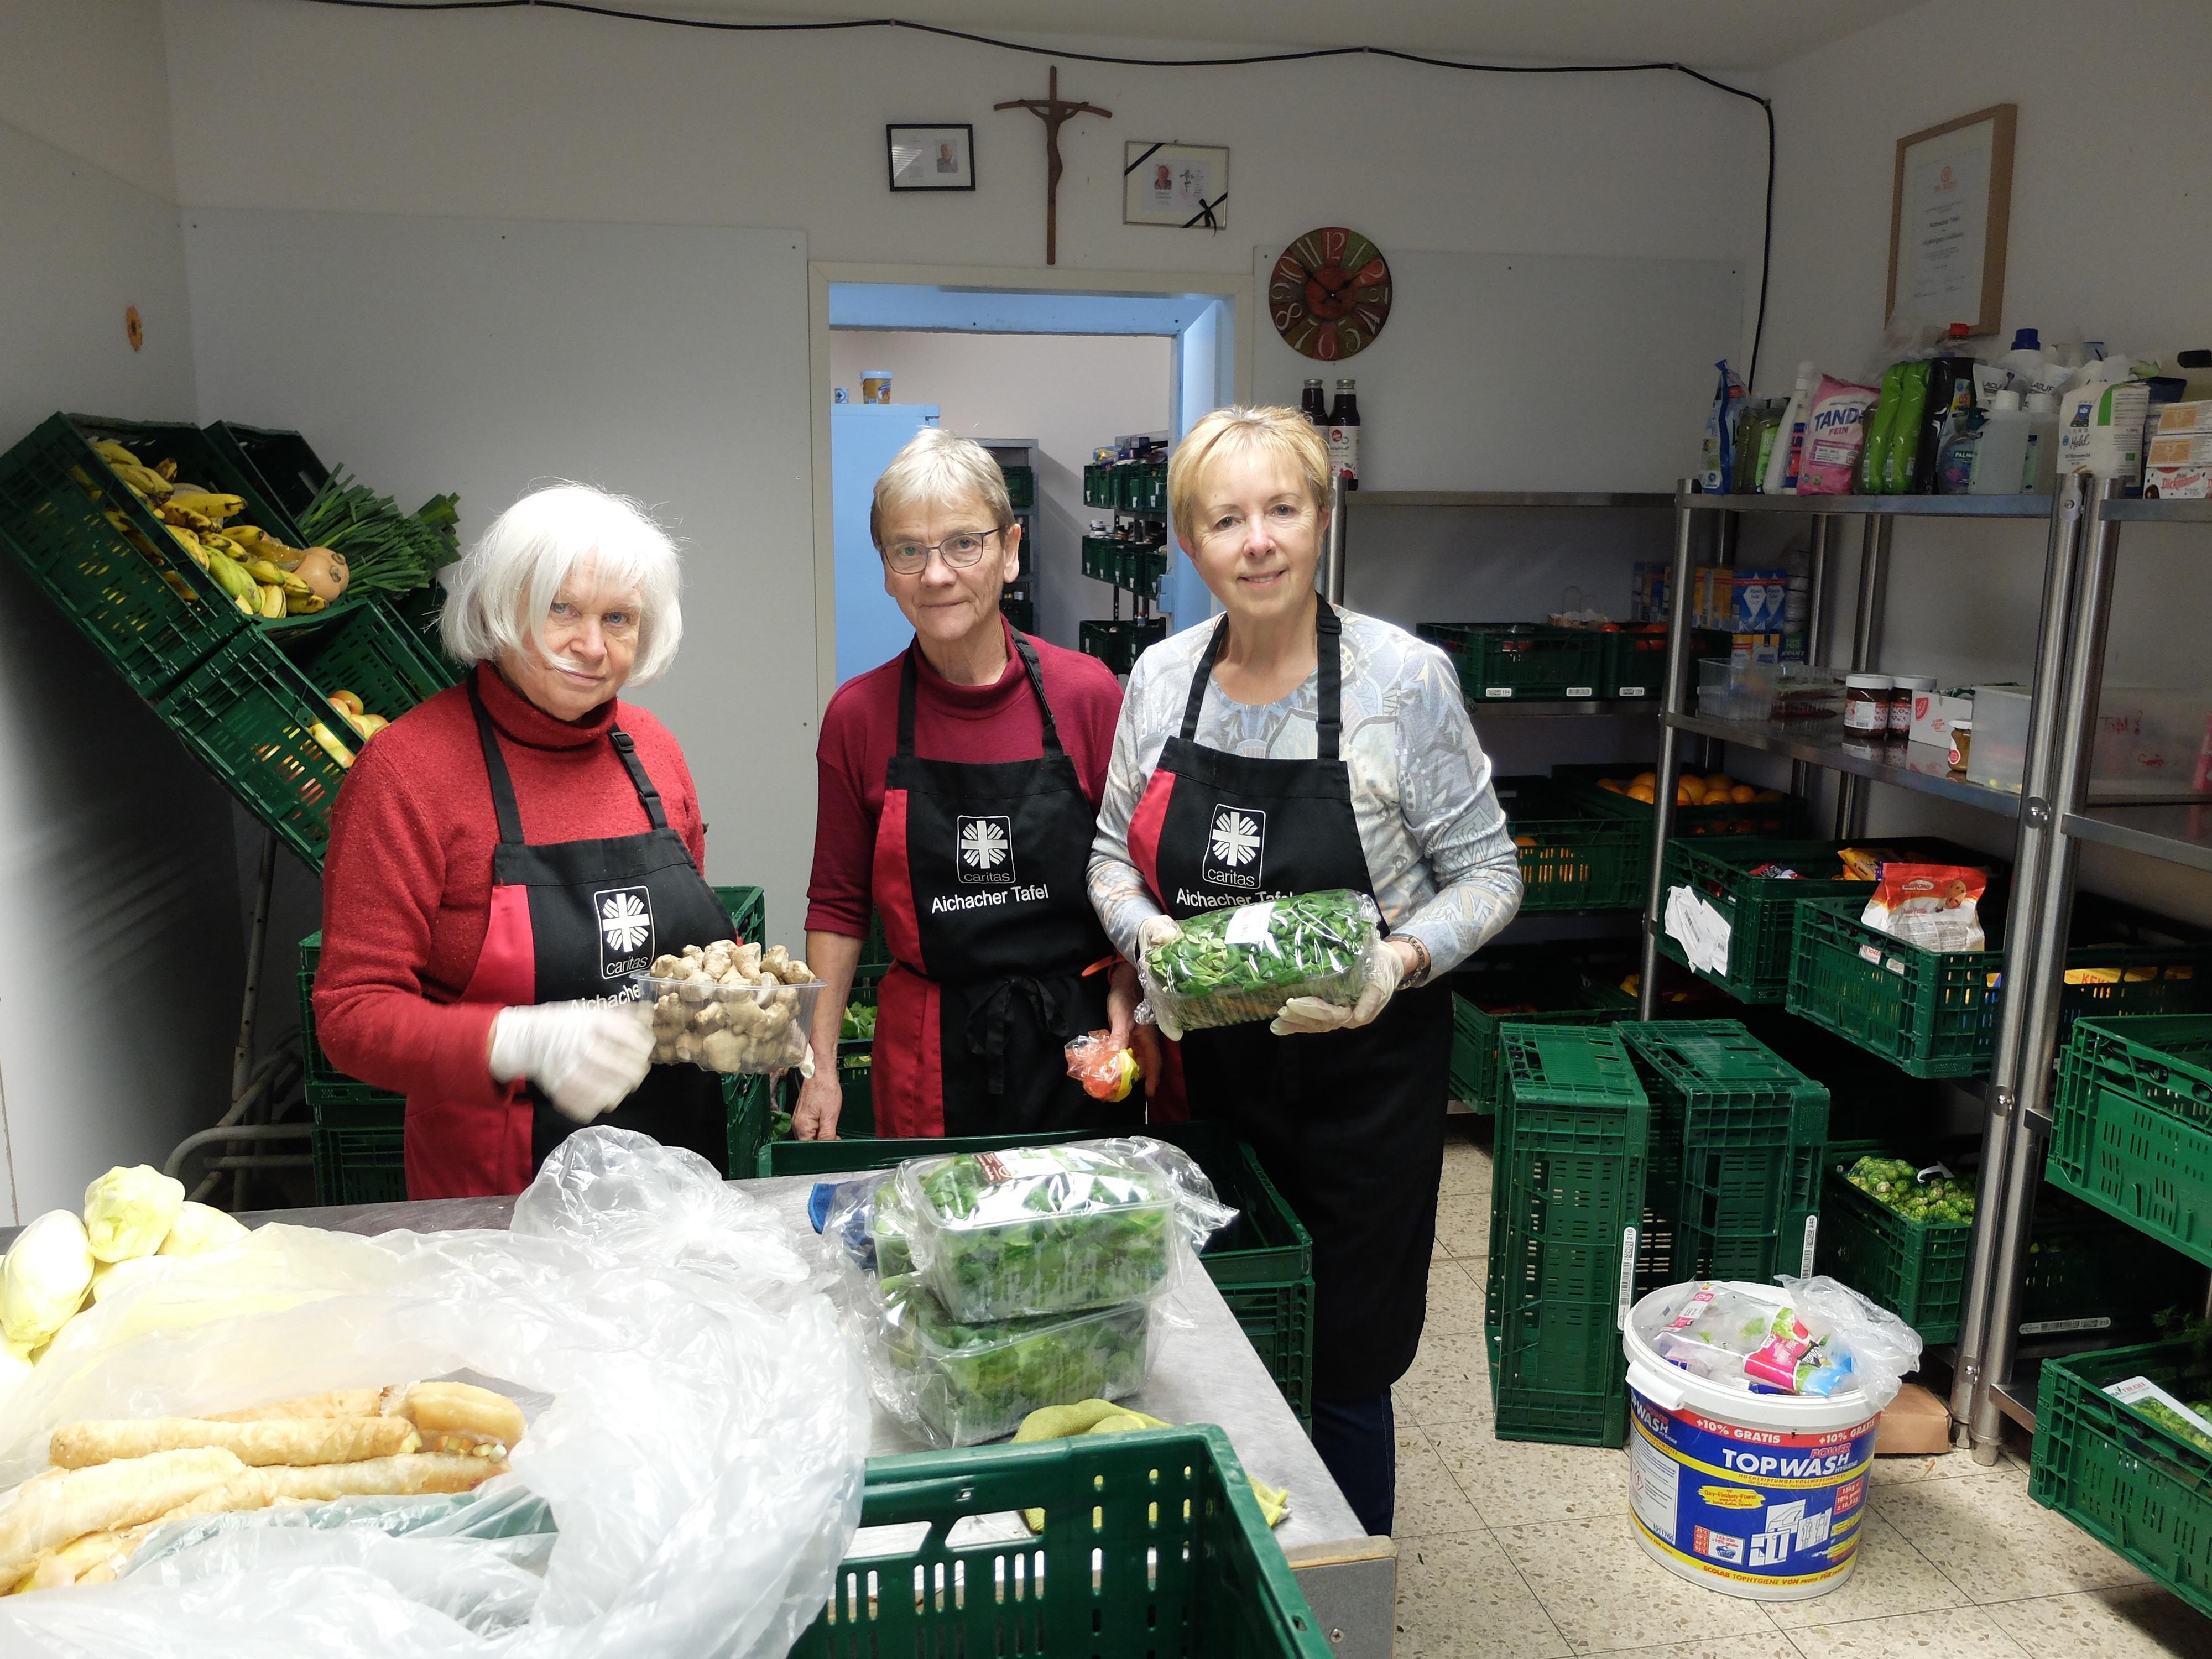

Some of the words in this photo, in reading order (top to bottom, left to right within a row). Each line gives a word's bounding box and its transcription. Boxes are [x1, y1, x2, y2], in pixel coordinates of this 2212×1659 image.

[1297, 237, 1322, 267] 11
[1327, 231, 1345, 260] 12
[1348, 242, 1367, 267] 1
[1279, 256, 1305, 284] 10
[1359, 259, 1385, 284] 2
[1271, 283, 1291, 299] 9
[1368, 287, 1388, 304] 3
[1276, 302, 1302, 331] 8
[1358, 306, 1380, 334] 4
[1294, 319, 1318, 349] 7
[1318, 333, 1335, 358] 6
[1338, 319, 1361, 352] 5
[1828, 426, 1849, 435] FEIN
[963, 872, 1010, 882] caritas
[1207, 869, 1255, 887] caritas
[931, 890, 1008, 914] Aichacher
[1010, 884, 1050, 902] Tafel
[1176, 888, 1252, 908] Aichacher
[1255, 891, 1293, 902] Taf
[606, 956, 649, 975] caritas
[570, 983, 643, 1013] Aichache
[1696, 1418, 1729, 1436] +10%
[1734, 1428, 1781, 1444] GRATIS
[1819, 1431, 1847, 1444] +10%
[1850, 1417, 1875, 1438] GRATIS
[1810, 1442, 1851, 1459] POWER
[1703, 1565, 1730, 1578] ECOLAB
[1732, 1574, 1779, 1585] TOPHYGIENE
[1819, 1571, 1832, 1580] FÜR
